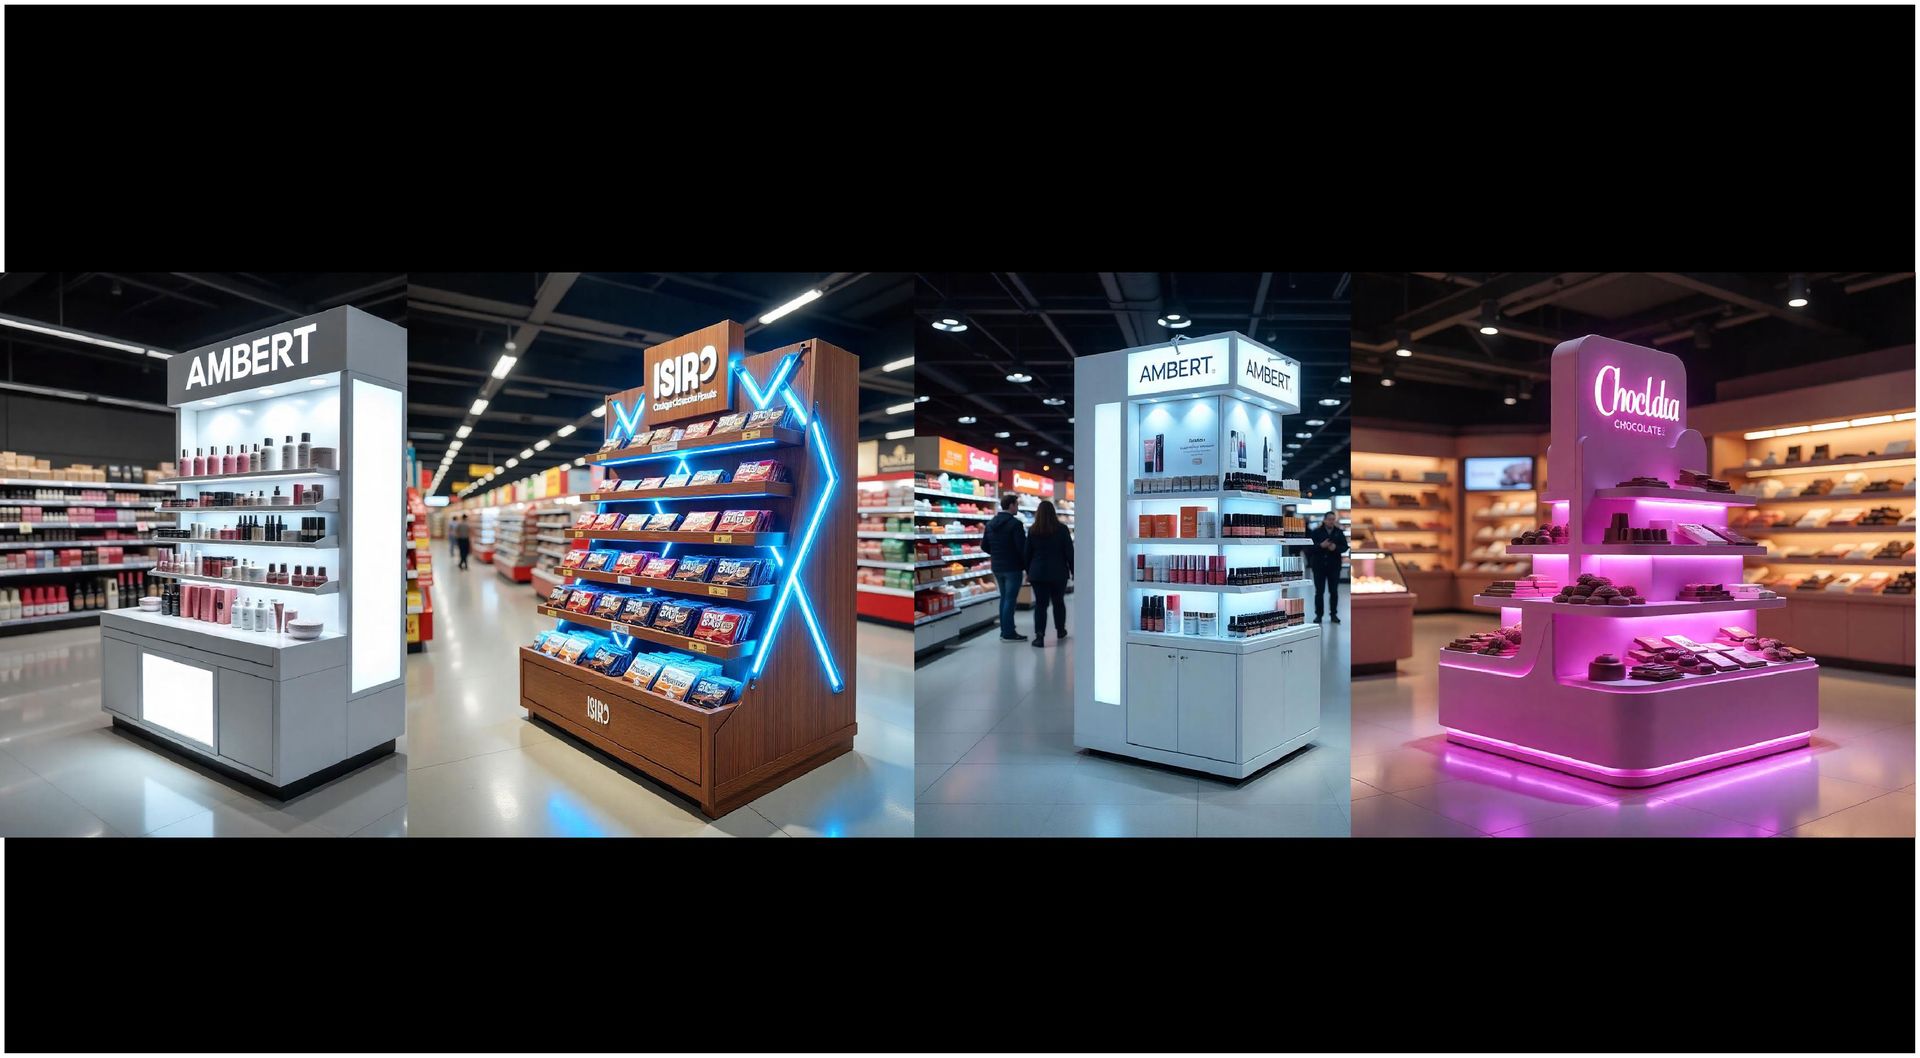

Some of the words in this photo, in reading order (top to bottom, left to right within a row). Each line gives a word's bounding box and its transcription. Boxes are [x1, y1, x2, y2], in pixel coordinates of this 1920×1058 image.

[185, 323, 317, 390] AMBERT
[1140, 356, 1213, 383] AMBERT
[1246, 359, 1290, 391] AMBERT
